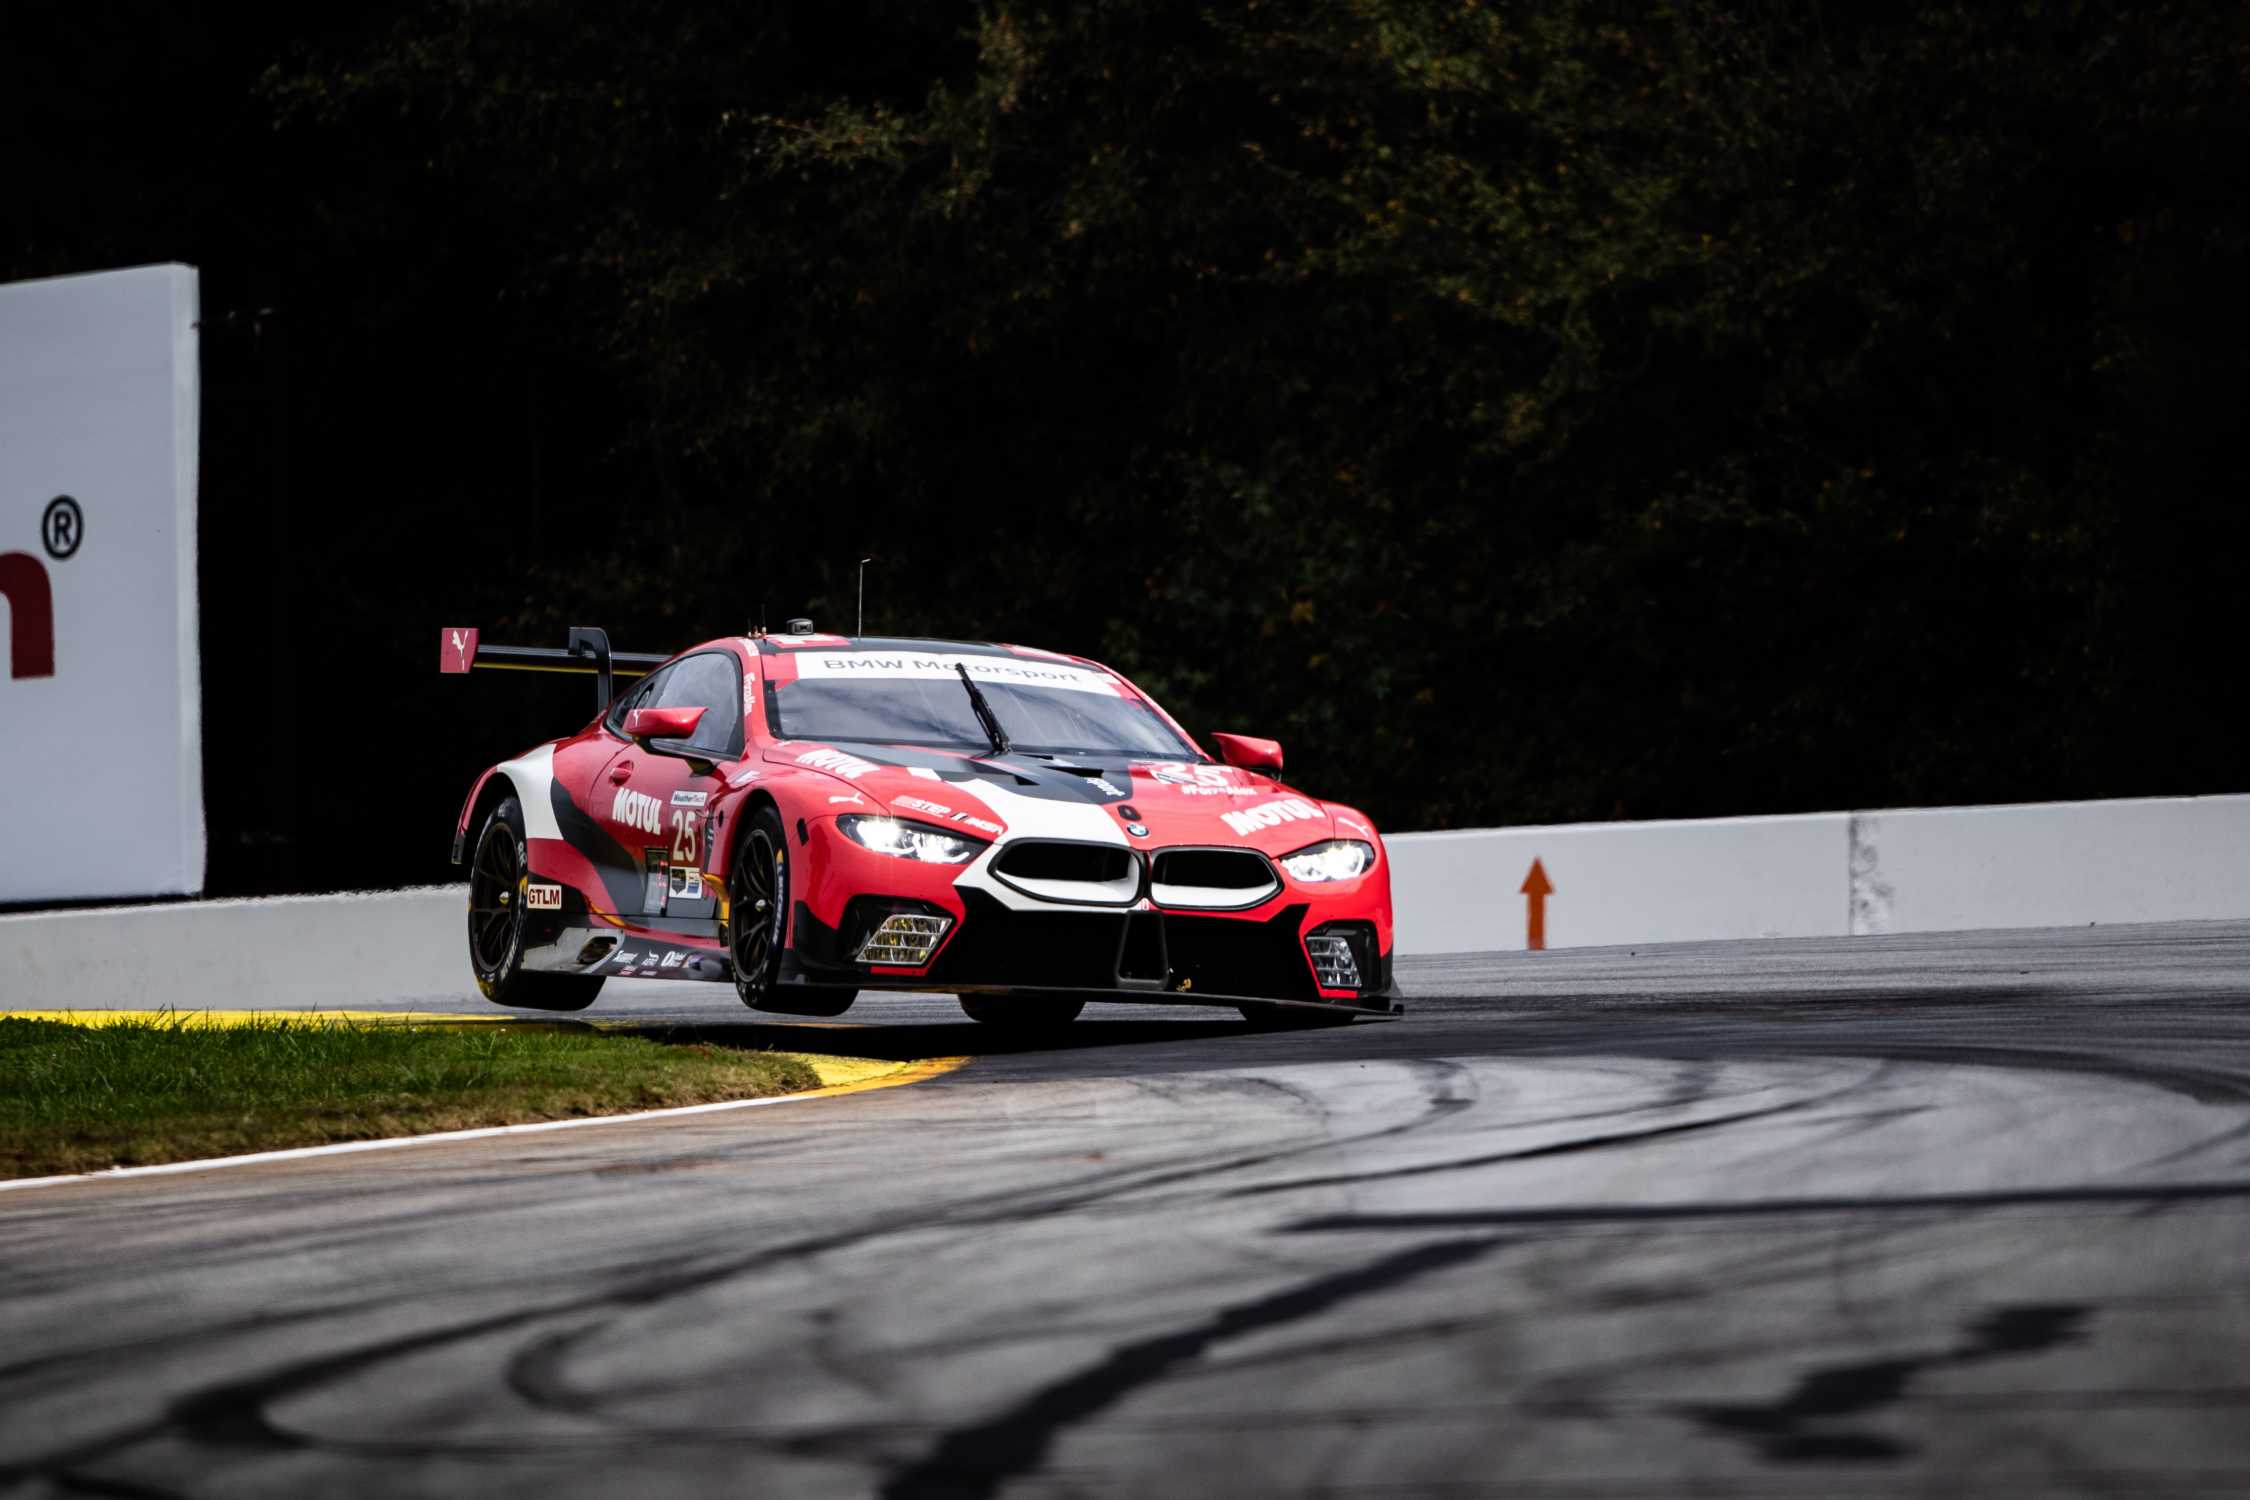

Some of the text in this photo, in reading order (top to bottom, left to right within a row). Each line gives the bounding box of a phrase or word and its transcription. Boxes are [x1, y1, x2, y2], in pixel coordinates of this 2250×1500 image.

[823, 659, 1079, 682] BMW Moorsport
[794, 748, 881, 780] MOTUL
[612, 786, 663, 836] MOTUL
[1219, 797, 1326, 837] MOTUL
[671, 809, 697, 863] 25
[528, 888, 561, 905] GTLM
